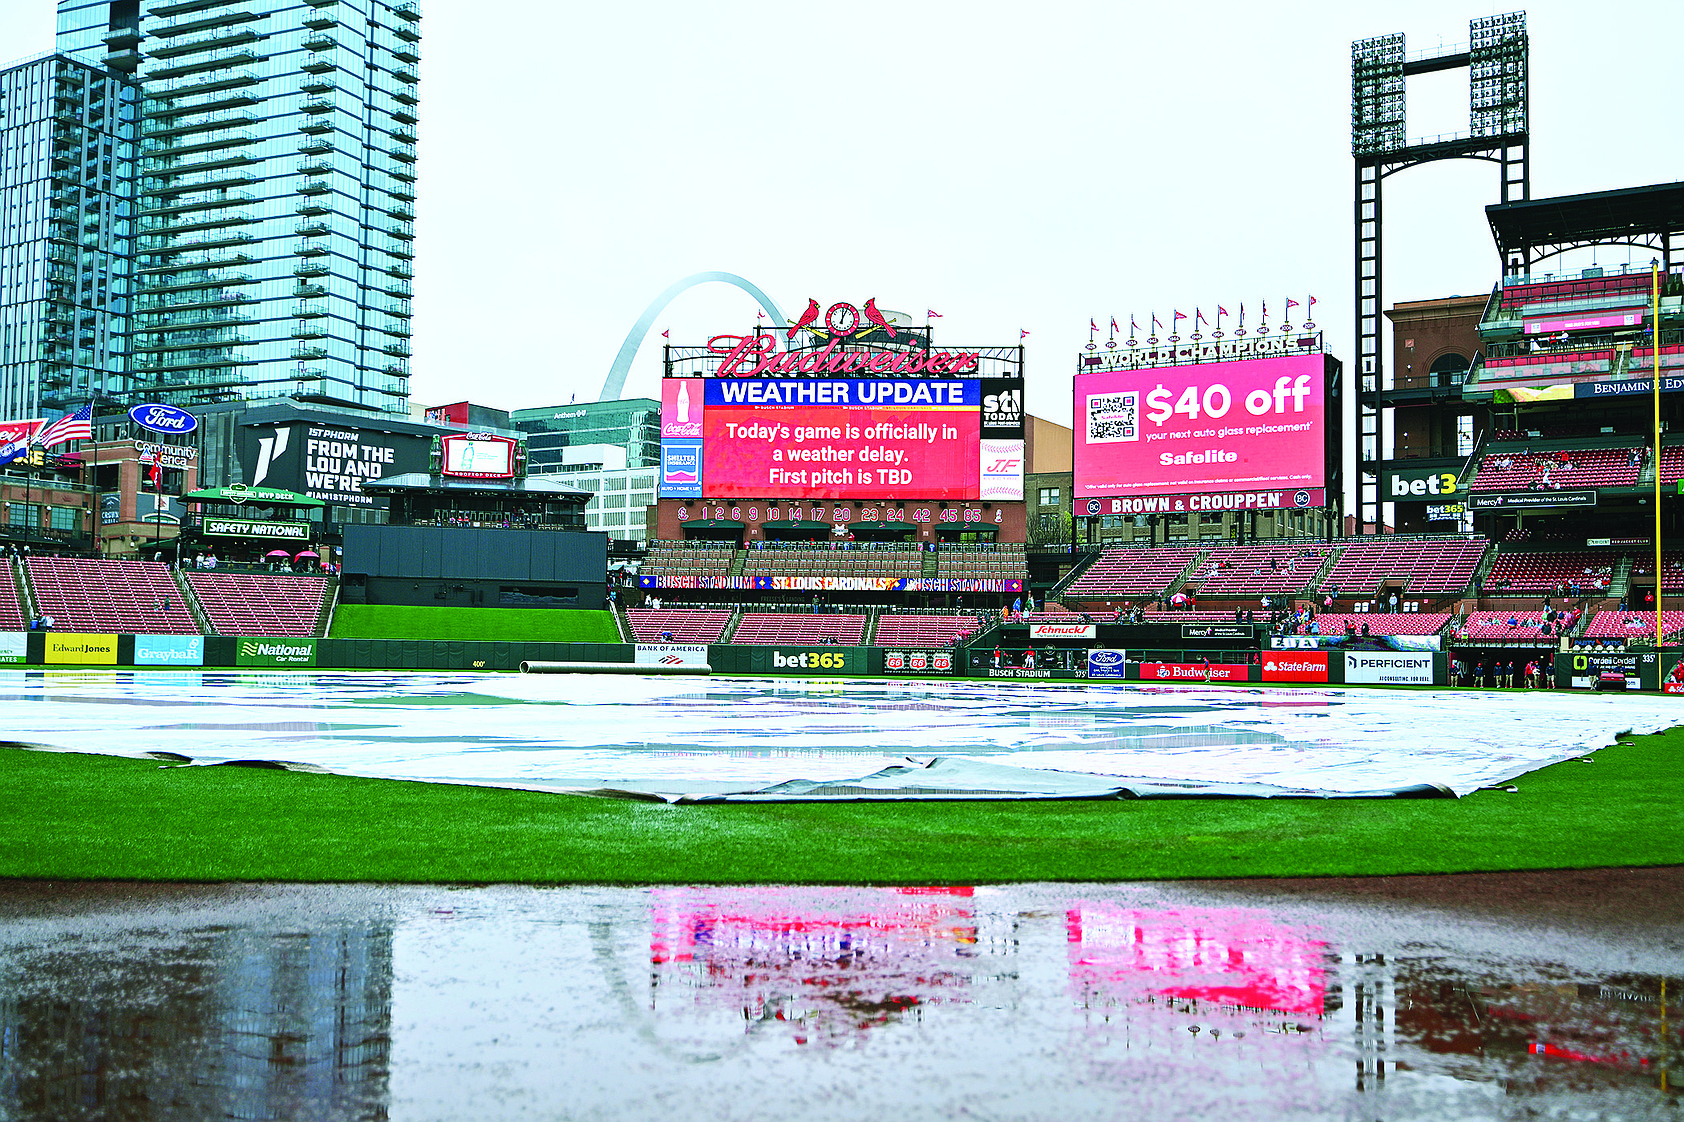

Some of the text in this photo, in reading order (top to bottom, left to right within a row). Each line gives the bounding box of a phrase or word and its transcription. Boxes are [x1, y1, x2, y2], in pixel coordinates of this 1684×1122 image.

[707, 334, 979, 378] Budweiser
[1100, 340, 1298, 366] WORLD CHAMPIONS
[721, 382, 963, 403] WEATHER UPDATE
[1594, 382, 1650, 394] BENJAMIN
[984, 390, 1020, 412] stl
[1146, 375, 1311, 426] $40 off
[145, 407, 185, 429] Ford
[664, 422, 702, 435] Coca-Cola
[726, 423, 957, 443] Today's game is officially in
[1146, 432, 1167, 442] your
[1170, 430, 1191, 439] next
[1193, 429, 1215, 438] auto
[1218, 427, 1244, 438] glass
[135, 440, 196, 459] Community
[307, 439, 394, 463] FROM THE
[773, 446, 908, 465] a weather delay.
[1159, 449, 1238, 465] Safelite
[307, 455, 381, 478] LOU AND
[306, 472, 361, 492] WE'RE
[769, 469, 912, 487] First pitch is TBD
[1089, 503, 1099, 511] BC
[1112, 493, 1280, 513] BROWN & CROUPPEN
[1296, 494, 1308, 503] BC
[1477, 499, 1497, 507] Mercy
[702, 507, 708, 520] 1
[715, 507, 724, 520] 2
[732, 507, 741, 520] 6
[749, 507, 758, 520] 9
[767, 508, 779, 520] 10
[789, 508, 802, 521] 14
[811, 508, 825, 521] 17
[833, 508, 850, 521] 20
[862, 508, 878, 521] 23
[887, 509, 904, 522] 24
[913, 509, 930, 522] 42
[940, 509, 957, 522] 45
[964, 509, 981, 522] 85
[1426, 505, 1463, 513] bet365
[209, 523, 304, 537] SAFETY NATIONAL
[658, 575, 696, 588] BUSCH
[699, 576, 755, 589] STADIUM
[792, 577, 825, 590] LOUIS
[826, 577, 886, 590] CARDINALS
[951, 579, 1005, 592] STADIUM
[53, 644, 110, 653] Edward Jones
[1095, 651, 1117, 663] Ford
[773, 651, 845, 668] bet365
[1361, 659, 1430, 668] PERFICIENT
[989, 669, 1050, 677] BUSCH STADIUM
